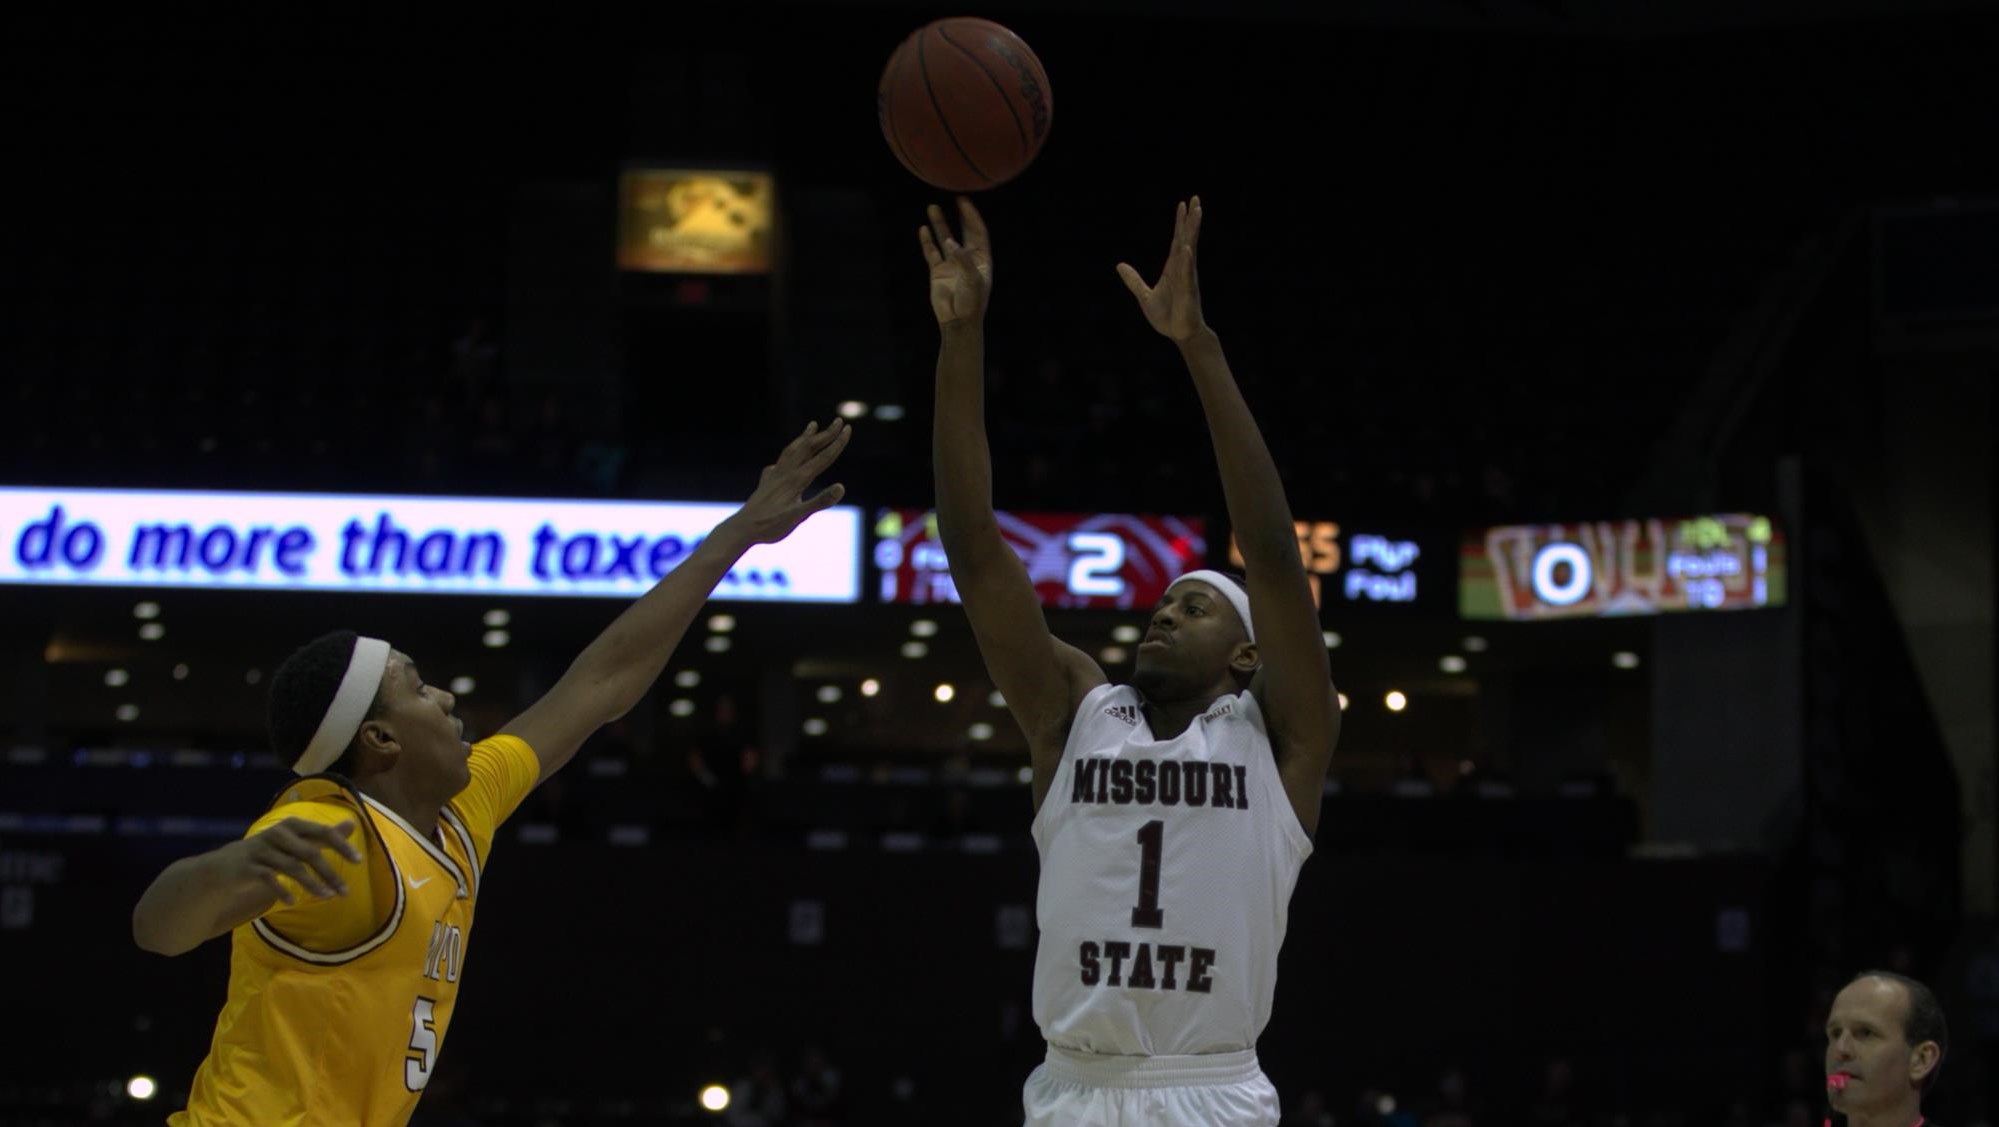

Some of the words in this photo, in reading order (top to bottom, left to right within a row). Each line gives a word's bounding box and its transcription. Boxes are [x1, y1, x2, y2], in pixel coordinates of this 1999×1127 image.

[16, 503, 102, 570] do
[127, 522, 312, 577] more
[339, 511, 502, 578] than
[531, 521, 788, 587] taxe...
[1065, 530, 1125, 596] 2
[1531, 541, 1592, 606] 0
[1071, 758, 1248, 809] MISSOURI
[1131, 820, 1163, 928] 1
[1079, 941, 1216, 993] STATE
[404, 995, 437, 1091] 5
